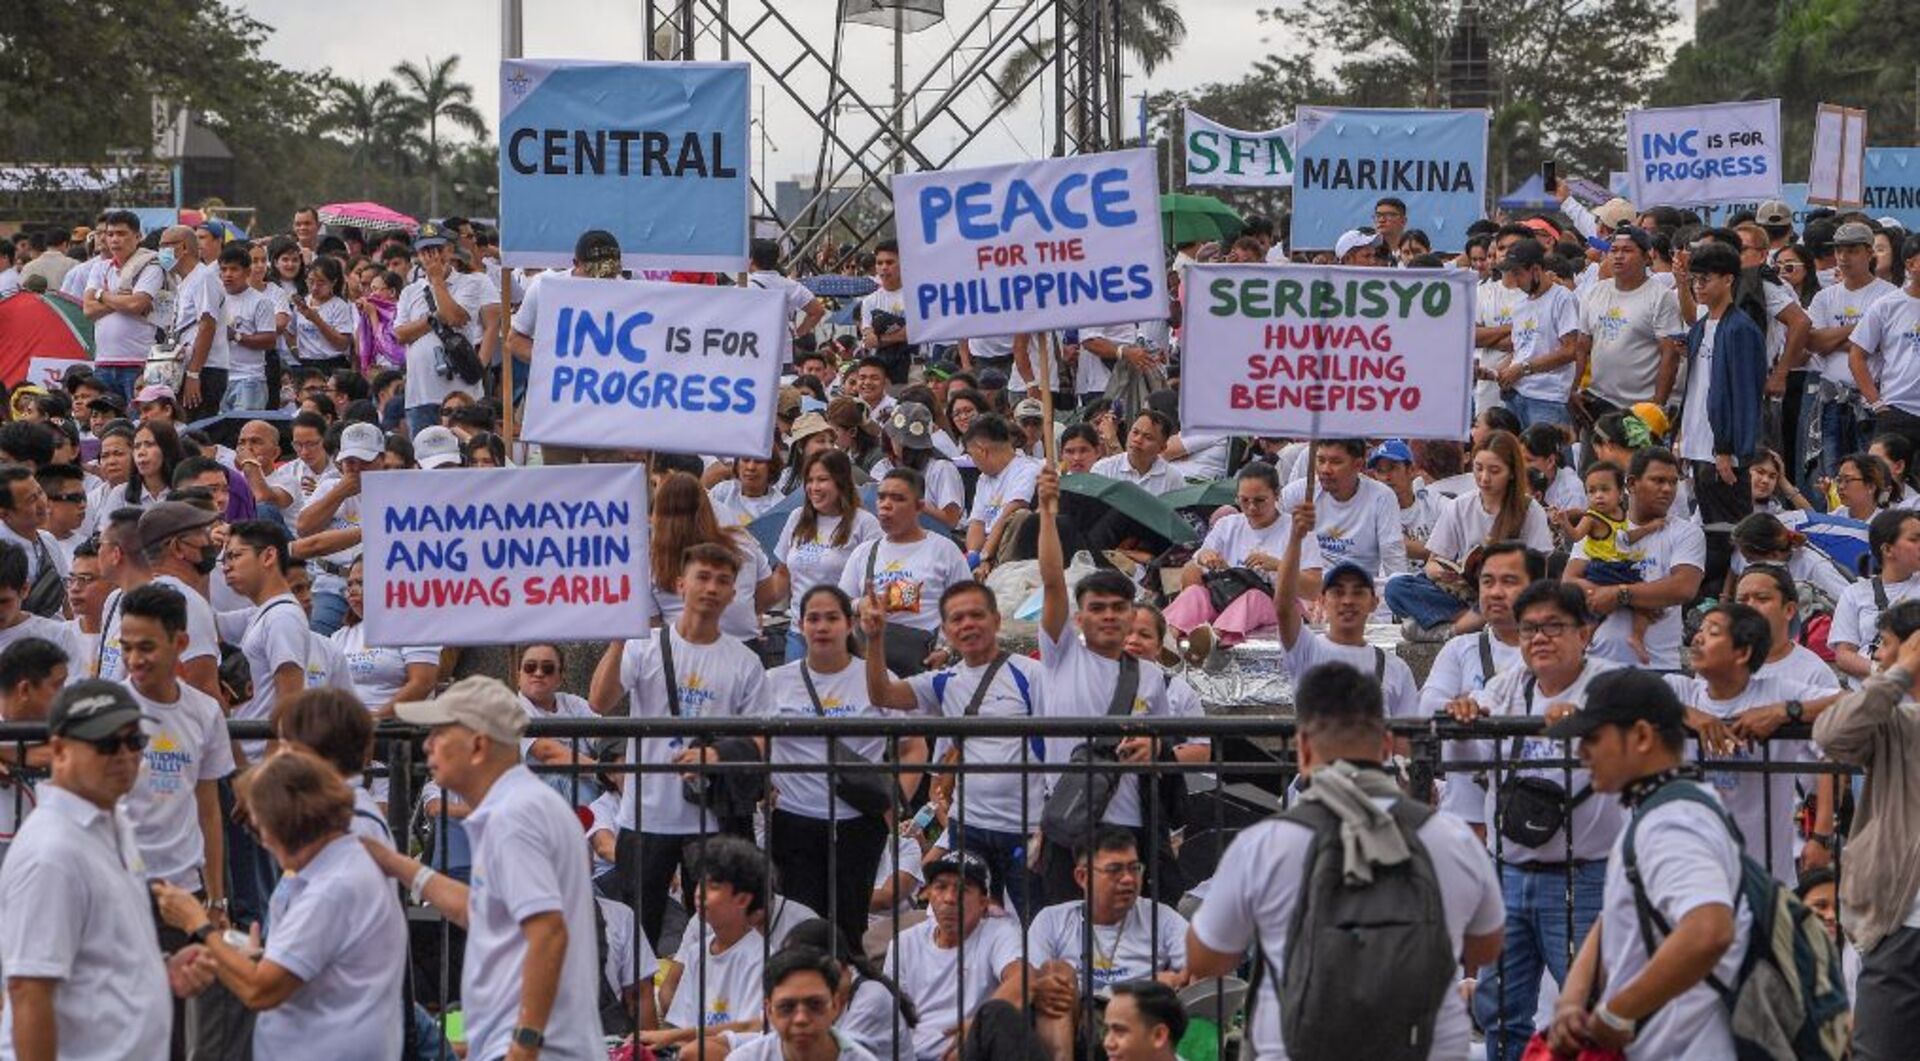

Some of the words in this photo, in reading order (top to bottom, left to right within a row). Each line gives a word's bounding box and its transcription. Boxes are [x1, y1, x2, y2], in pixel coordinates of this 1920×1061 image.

[508, 127, 737, 179] CENTRAL
[1642, 129, 1698, 160] INC
[1707, 134, 1724, 149] IS
[1729, 132, 1765, 148] FOR
[1303, 157, 1474, 192] MARIKINA
[1644, 155, 1768, 183] PROGRESS
[919, 167, 1138, 245] PEACE
[1862, 186, 1920, 209] ATAN
[977, 244, 1027, 270] FOR
[1035, 239, 1086, 263] THE
[917, 264, 1154, 320] PHILIPPINES
[1209, 279, 1452, 318] SERBISYO
[555, 307, 654, 364] INC
[665, 327, 692, 353] IS
[703, 328, 760, 358] FOR
[1264, 323, 1393, 352] HUWAG
[1247, 354, 1406, 383] SARILING
[551, 365, 757, 414] PROGRESS
[1230, 383, 1421, 412] BENEPISYO
[384, 501, 630, 534] MAMAMAYAN
[385, 537, 469, 572] ANG
[482, 535, 631, 570] UNAHIN
[385, 576, 512, 608] HUWAG
[523, 574, 631, 606] SARILI
